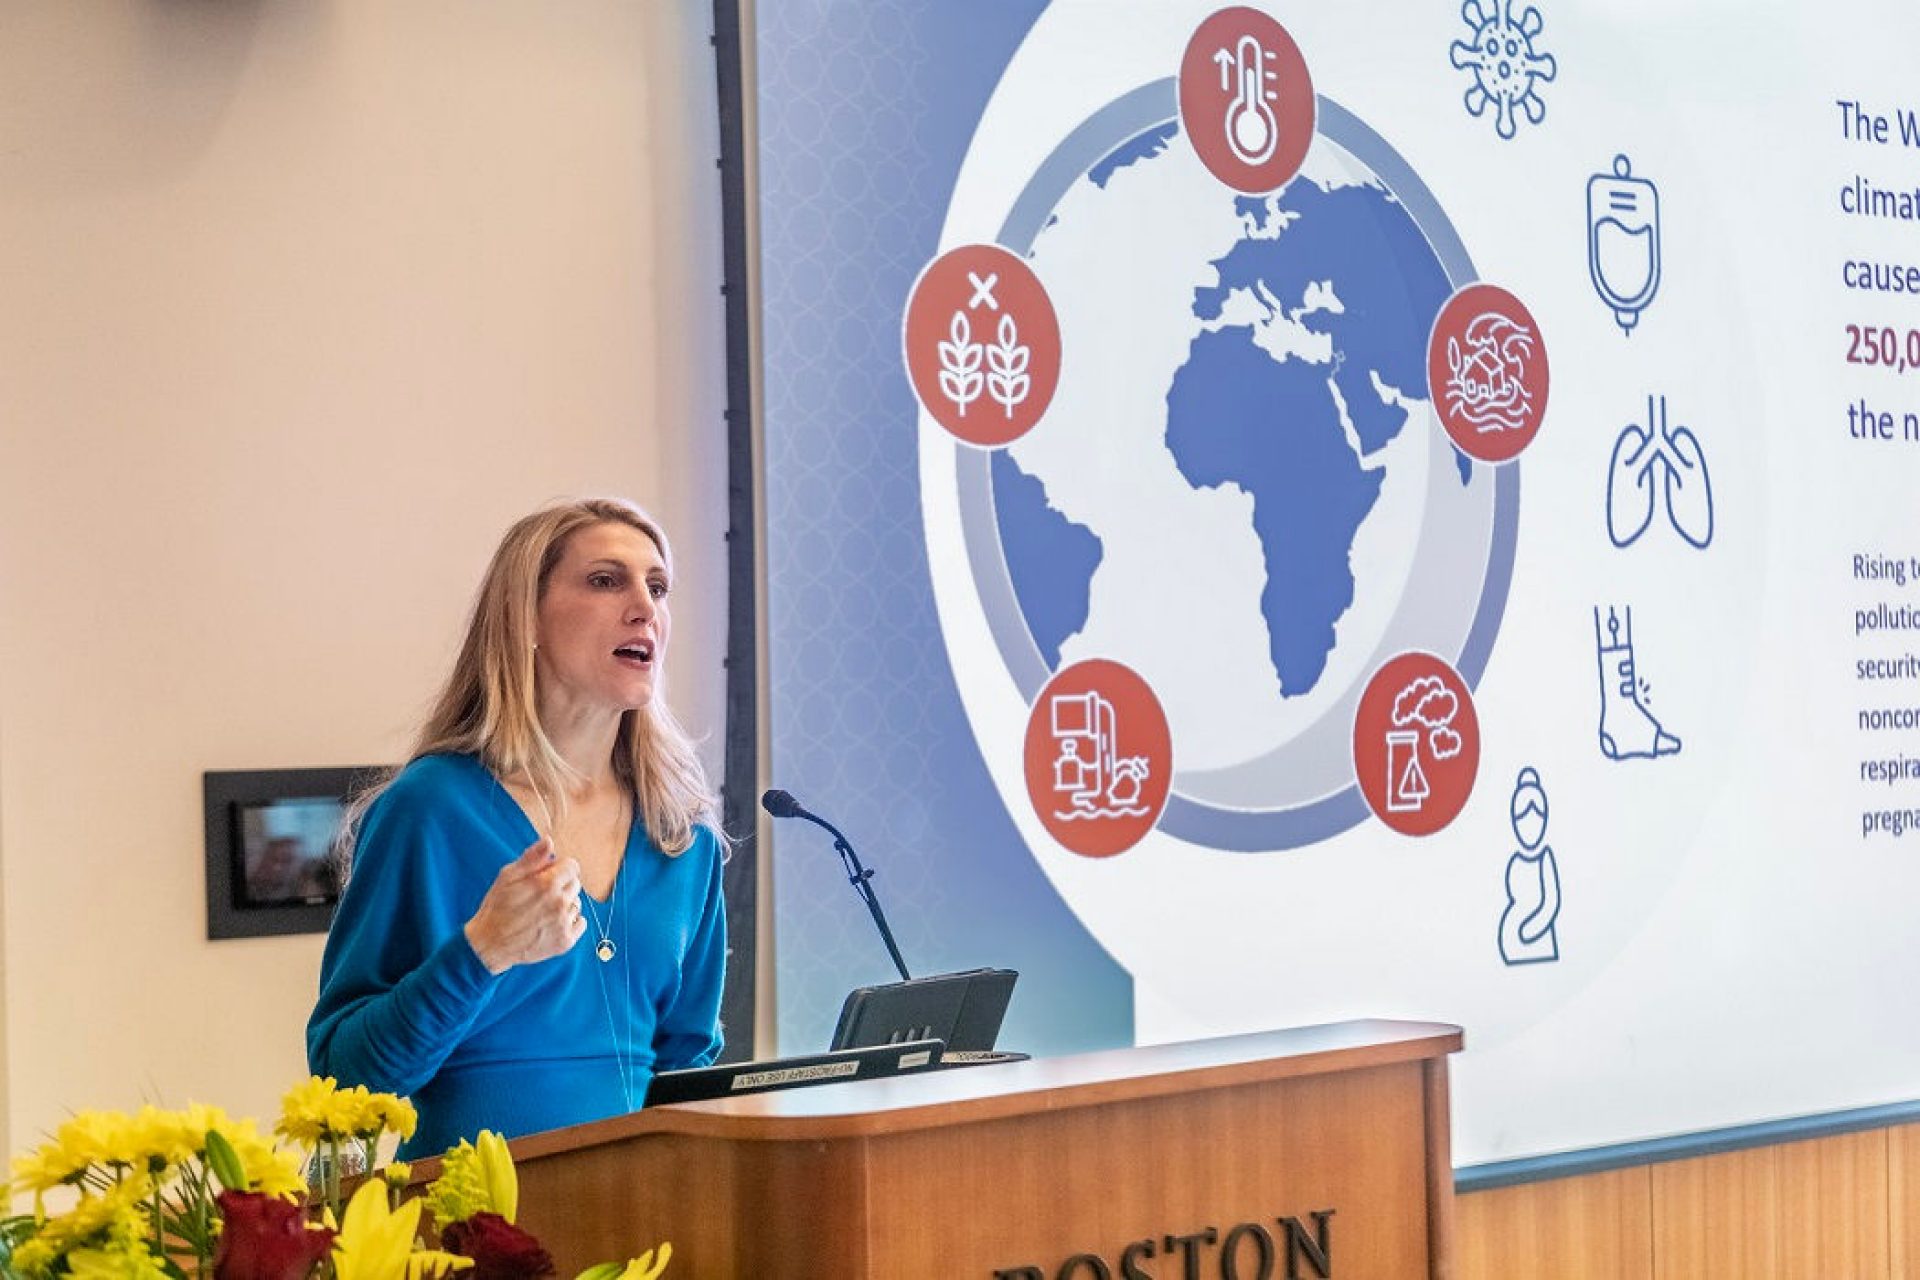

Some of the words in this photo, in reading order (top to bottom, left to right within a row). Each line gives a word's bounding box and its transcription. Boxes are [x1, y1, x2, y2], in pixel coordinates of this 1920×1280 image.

[1836, 100, 1888, 143] The
[1843, 260, 1920, 293] cause
[1845, 324, 1920, 374] 250,0
[1847, 398, 1894, 440] the
[1853, 553, 1905, 586] Rising
[1911, 557, 1920, 579] t
[992, 1209, 1335, 1280] STON
